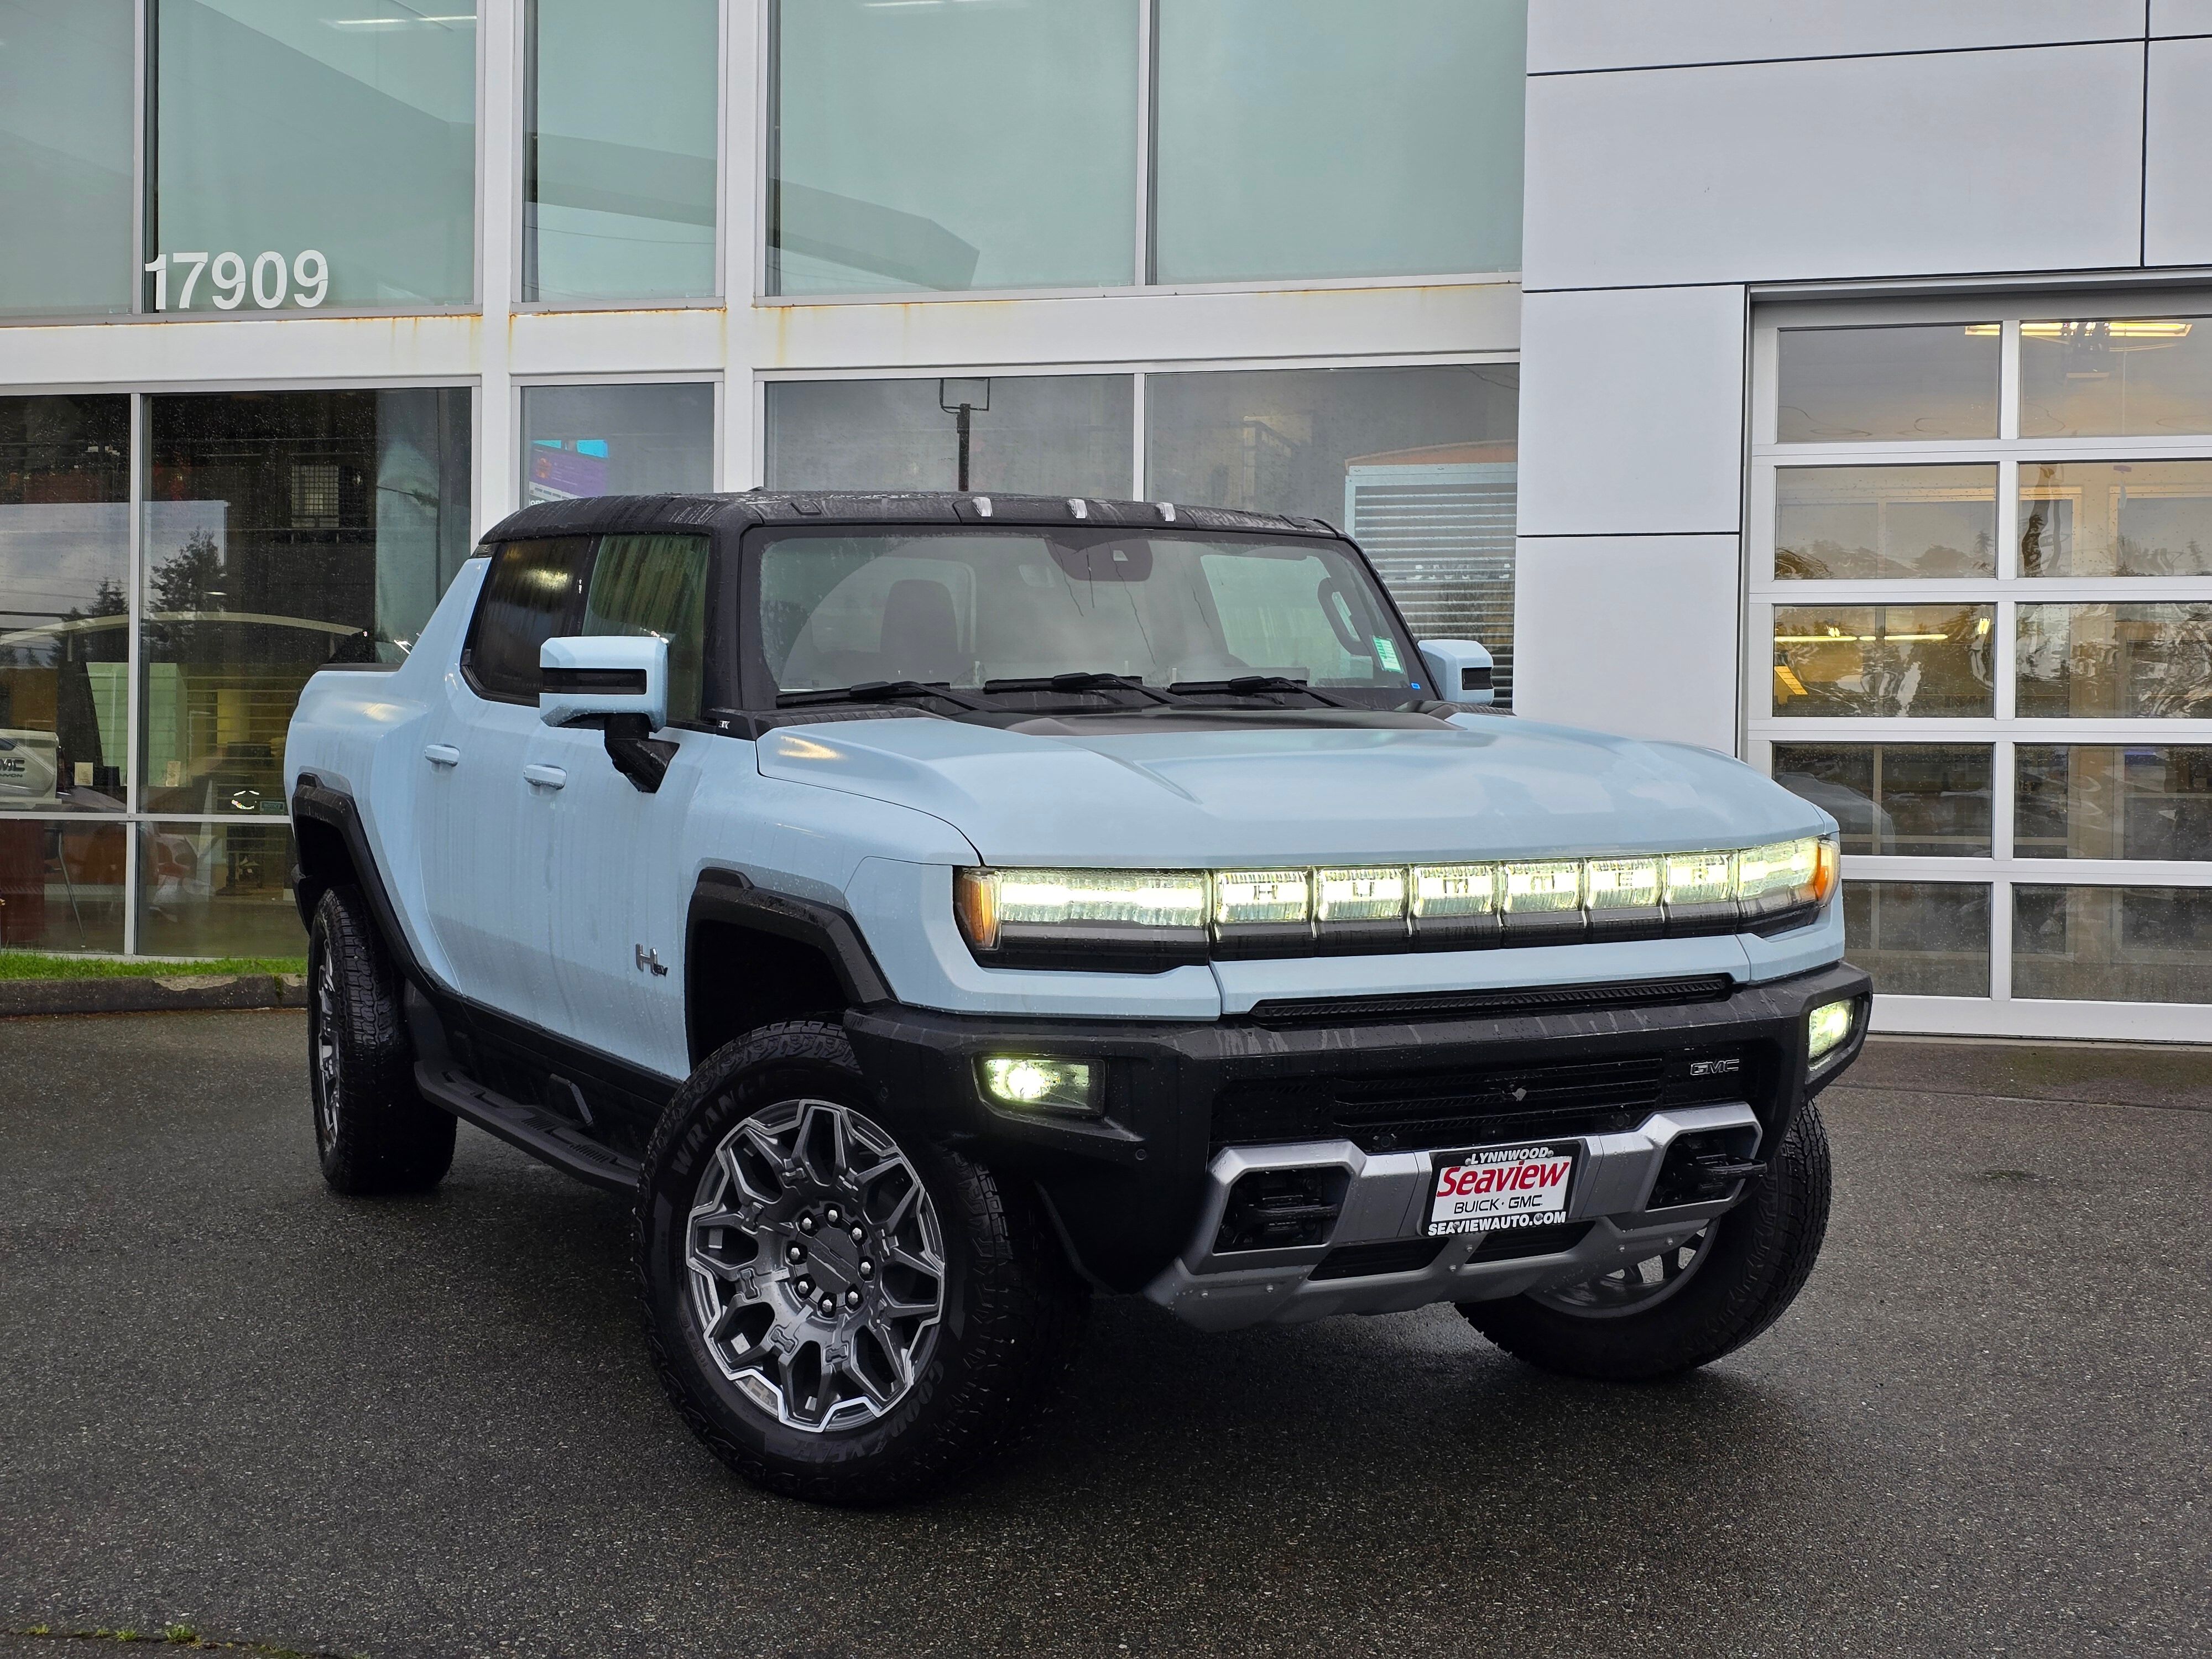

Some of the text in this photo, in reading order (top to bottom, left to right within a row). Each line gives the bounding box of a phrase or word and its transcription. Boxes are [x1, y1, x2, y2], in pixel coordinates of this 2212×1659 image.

[145, 249, 328, 310] 17909
[0, 758, 25, 771] MC
[1690, 1059, 1740, 1076] GMC
[1470, 1147, 1548, 1165] LYNNWOOD
[1437, 1160, 1570, 1197] Seaview
[1454, 1194, 1543, 1214] BUICK GMC
[1428, 1211, 1566, 1236] SEAVIEWAUTO.COM
